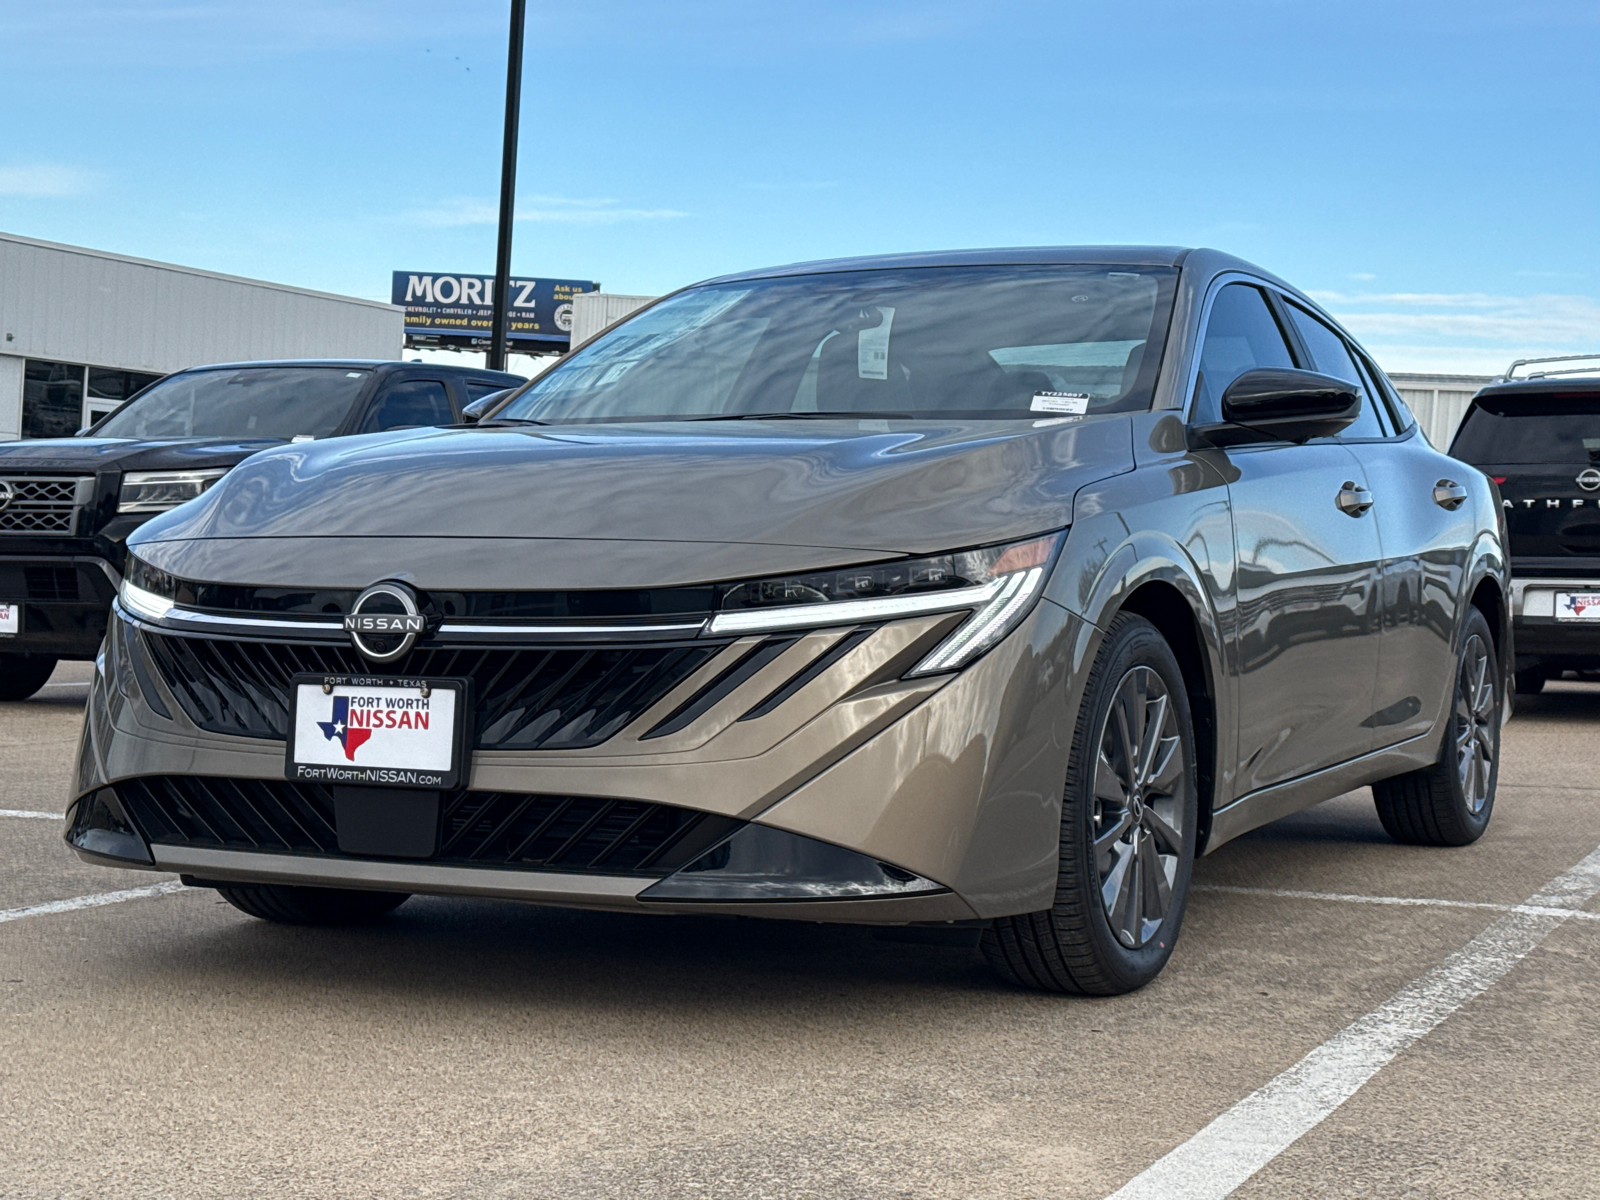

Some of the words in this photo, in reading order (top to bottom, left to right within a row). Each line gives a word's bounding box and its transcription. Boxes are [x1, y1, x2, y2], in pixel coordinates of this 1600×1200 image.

[405, 275, 536, 308] MORIZ
[554, 284, 570, 292] Ask
[442, 307, 472, 315] CHRYSLER
[404, 315, 432, 326] amily
[434, 317, 468, 326] owned
[471, 319, 493, 327] over
[511, 321, 540, 330] years
[345, 617, 420, 630] NISSAN
[324, 676, 347, 685] FORT
[351, 677, 384, 686] WORTH
[397, 679, 427, 688] TEXAS
[350, 696, 382, 709] FORT
[385, 697, 430, 710] WORTH
[349, 709, 430, 730] NISSAN
